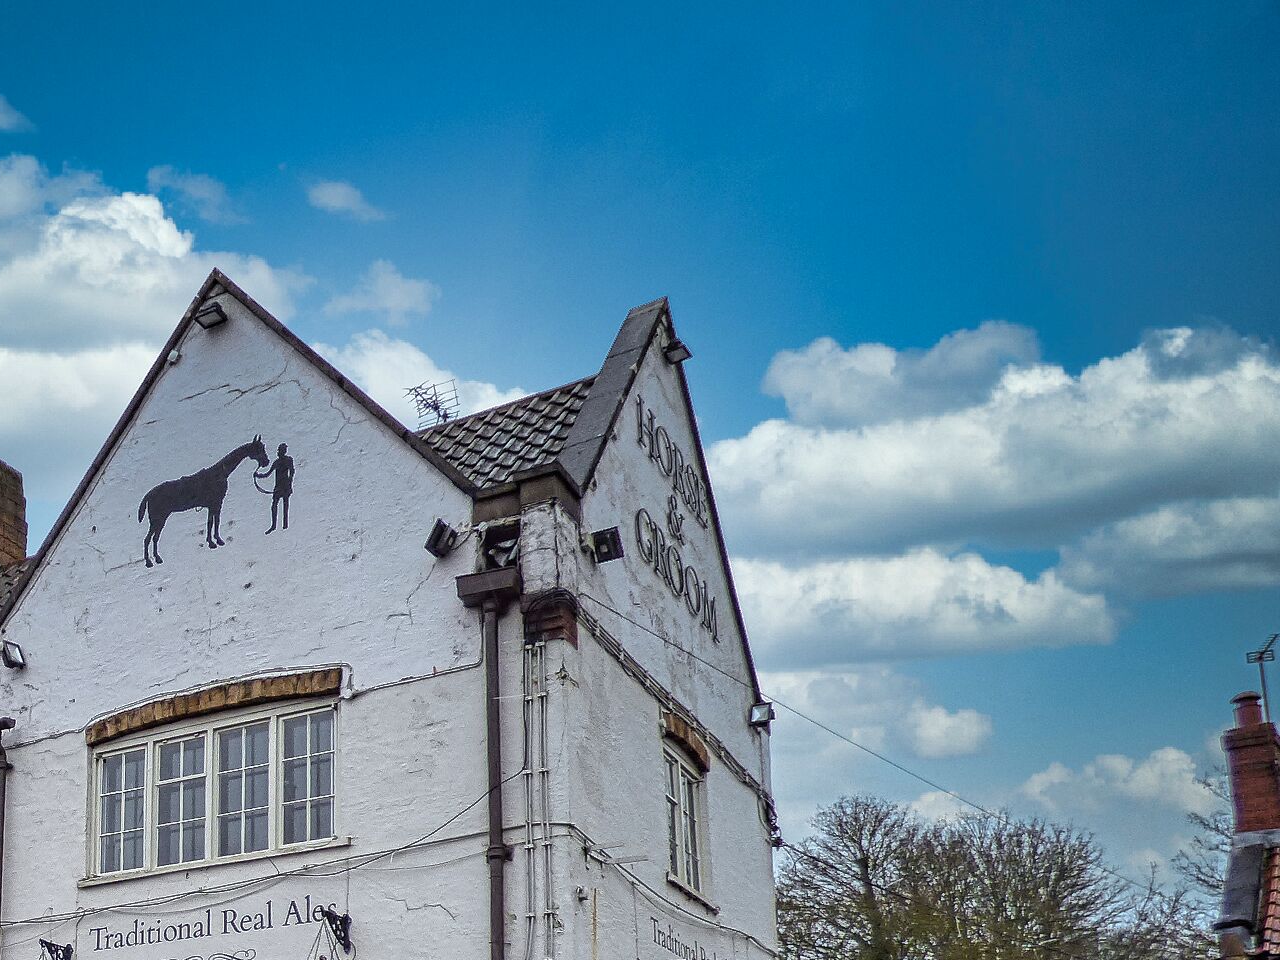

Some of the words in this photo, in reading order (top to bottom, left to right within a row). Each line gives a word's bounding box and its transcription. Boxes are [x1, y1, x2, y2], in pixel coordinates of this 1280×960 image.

[637, 393, 709, 530] HORSE
[668, 495, 686, 546] &
[635, 507, 721, 644] GROOM
[89, 909, 212, 951] Traditional
[221, 900, 272, 934] Real
